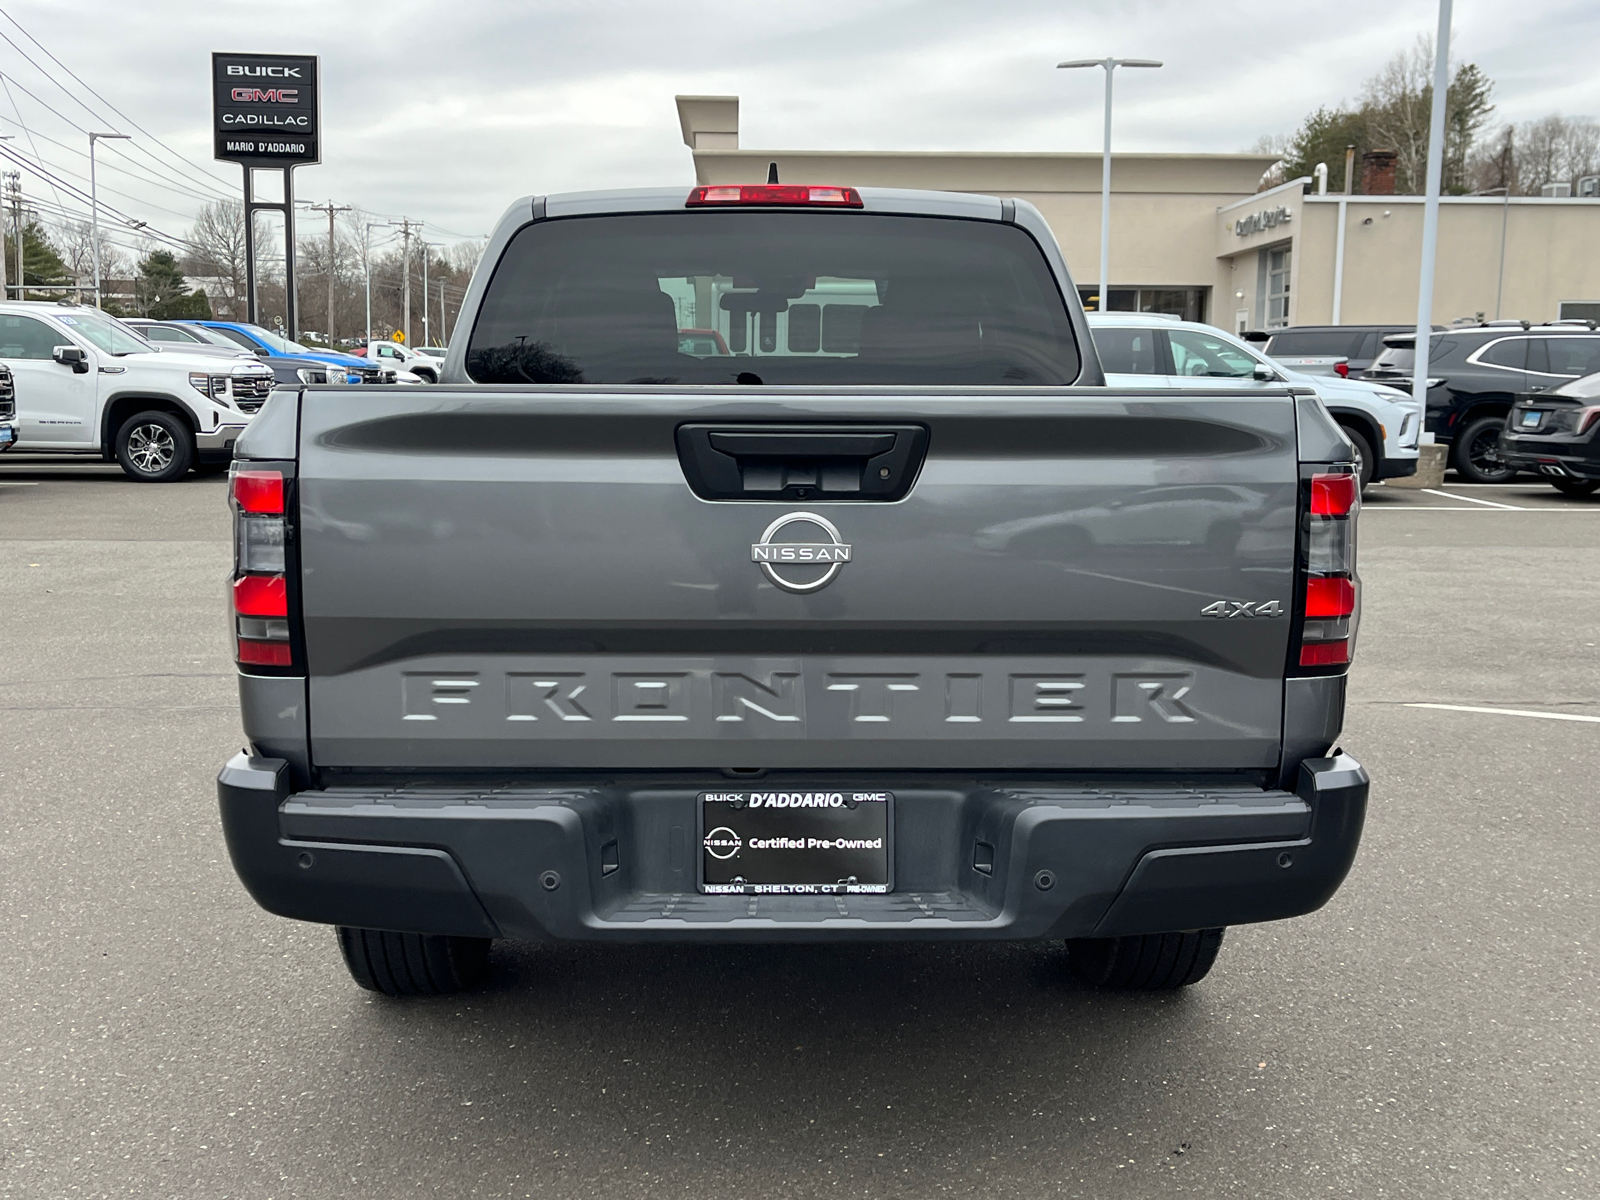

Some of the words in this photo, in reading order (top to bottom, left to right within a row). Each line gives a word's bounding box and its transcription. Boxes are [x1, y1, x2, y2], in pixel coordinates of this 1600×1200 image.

[226, 65, 302, 78] BUICK
[231, 87, 298, 103] GMC
[222, 114, 308, 125] CADILLAC
[226, 141, 254, 151] MARIO
[258, 142, 305, 153] D'ADDARIO
[754, 547, 849, 560] NISSAN
[401, 671, 1197, 722] FRONTIER
[705, 793, 744, 802] BUICK
[749, 793, 843, 808] D'ADDARIO
[852, 793, 886, 802] GMC
[703, 839, 742, 847] NISSAN
[748, 837, 805, 849] Certified
[807, 837, 882, 849] Pre-Owned
[754, 885, 818, 894] SHELTON,
[821, 885, 839, 893] CT
